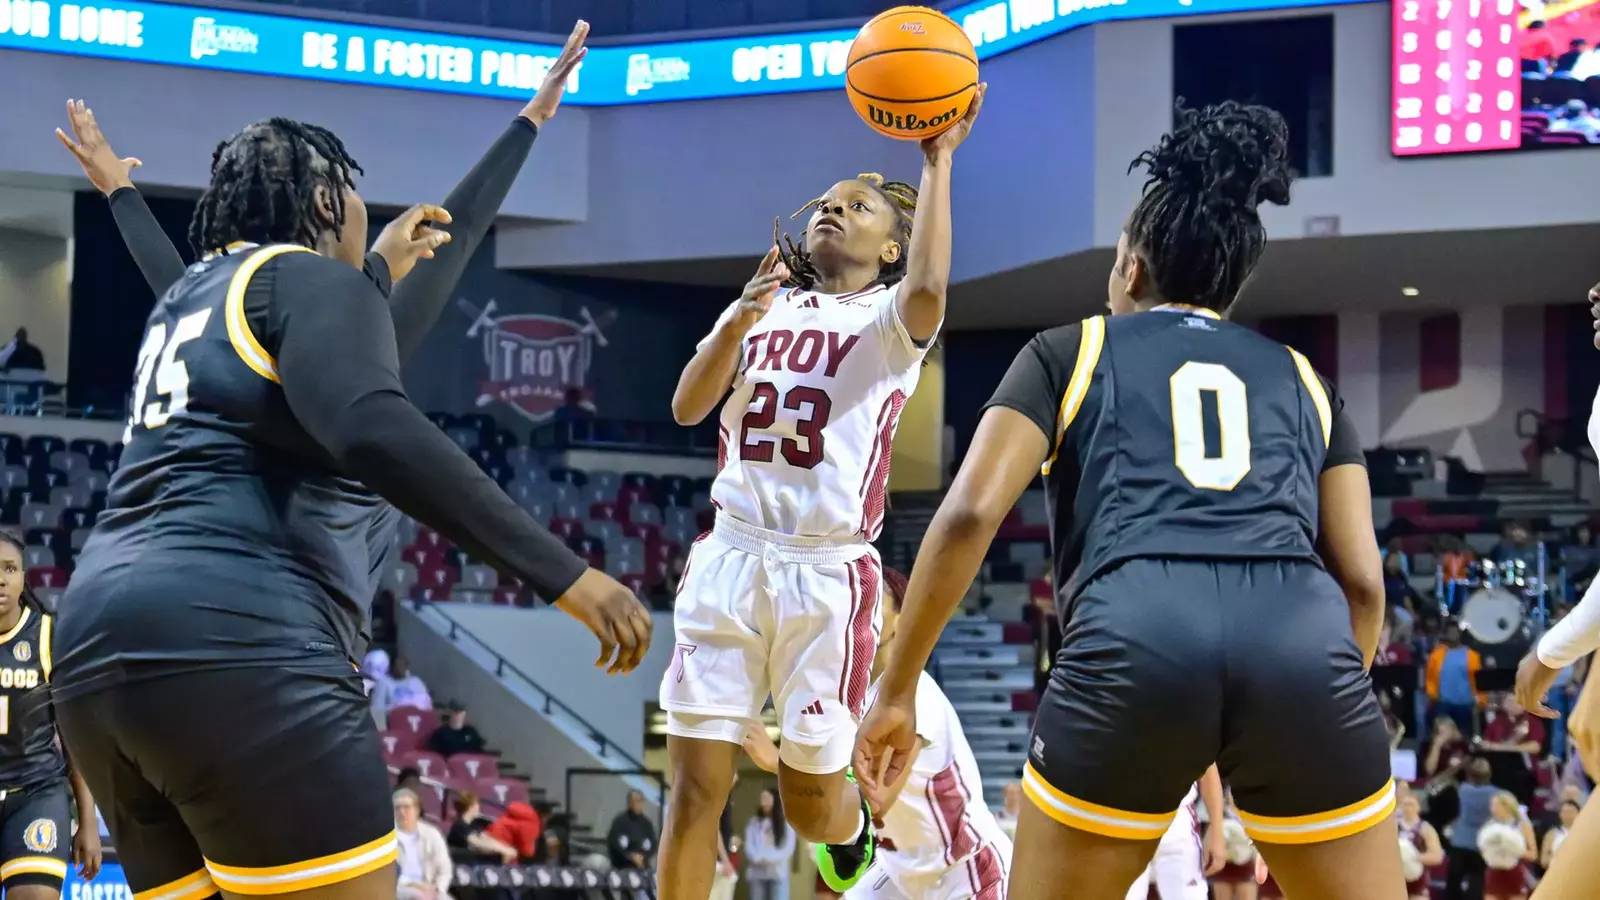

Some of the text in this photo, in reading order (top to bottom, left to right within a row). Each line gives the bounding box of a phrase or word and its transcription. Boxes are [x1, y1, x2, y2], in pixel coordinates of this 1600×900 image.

[60, 5, 143, 48] HOME
[302, 31, 338, 69] BE
[346, 36, 365, 72] A
[374, 39, 474, 83] FOSTER
[732, 43, 801, 82] OPEN
[868, 103, 957, 130] Wilson
[500, 339, 576, 384] TROY
[742, 329, 861, 378] TROY
[500, 384, 565, 400] TROJAN
[740, 381, 832, 470] 23
[1169, 360, 1251, 491] 0
[0, 667, 39, 689] OOD
